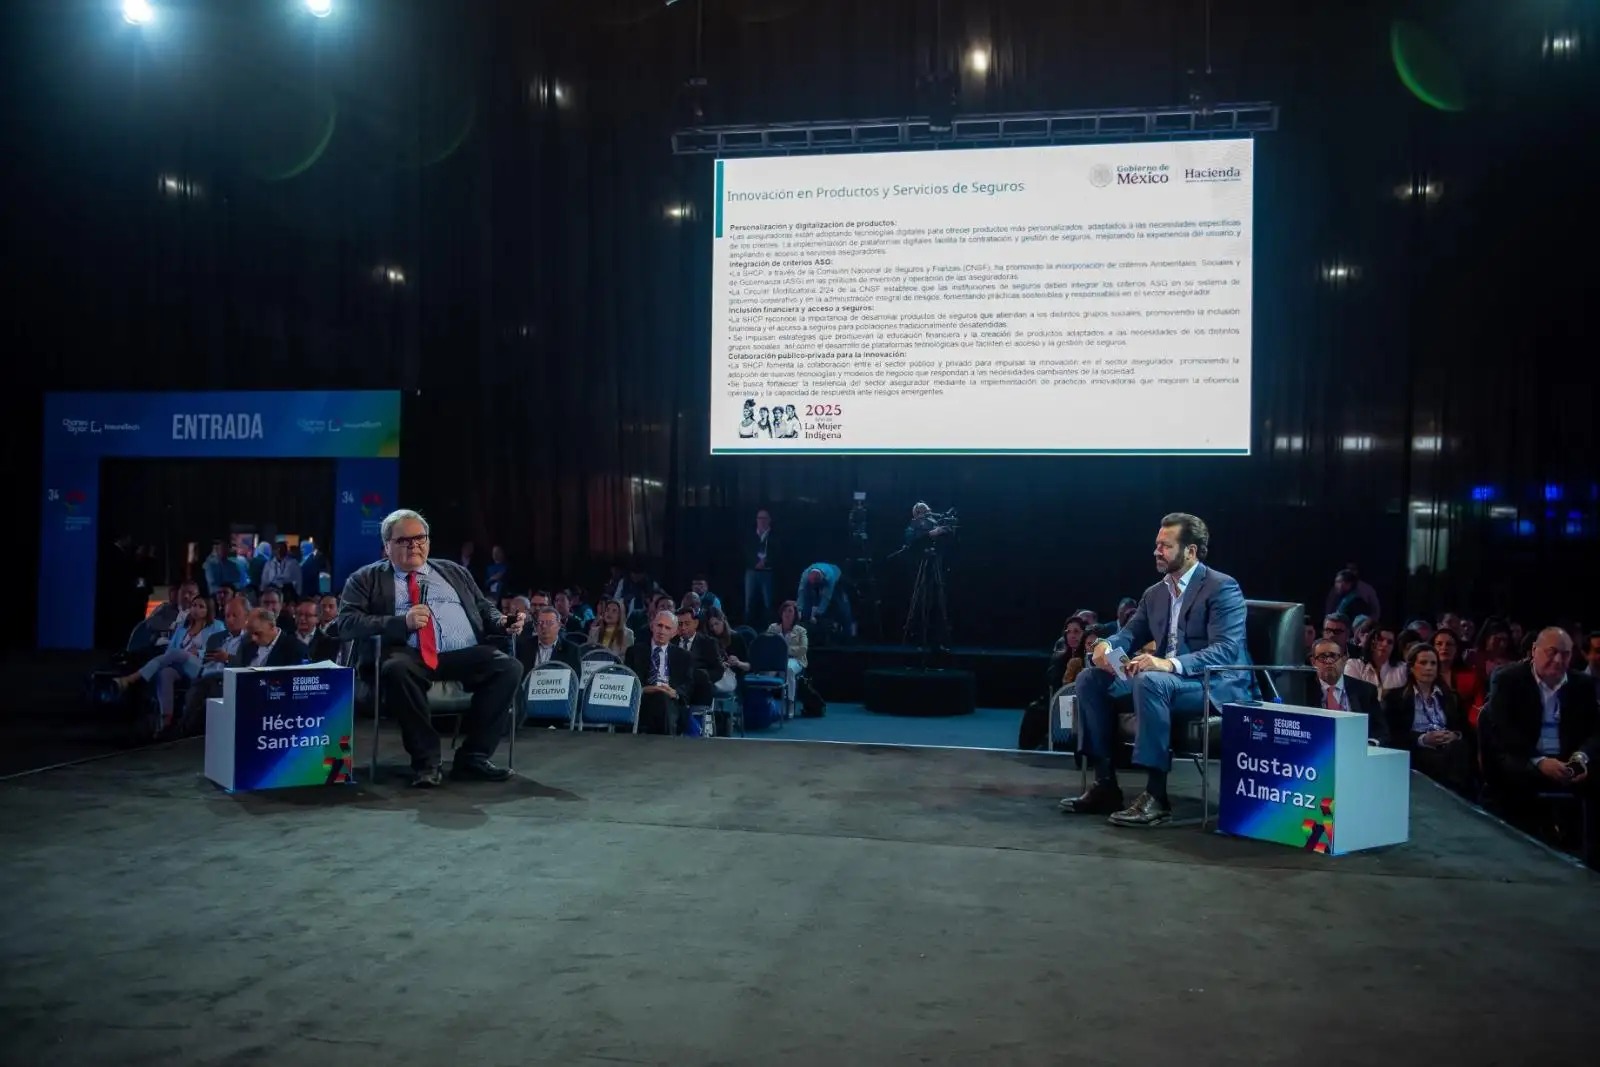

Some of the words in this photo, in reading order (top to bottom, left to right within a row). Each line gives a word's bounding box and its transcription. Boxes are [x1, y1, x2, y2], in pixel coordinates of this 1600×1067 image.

[1116, 164, 1157, 173] Gobierno
[1184, 166, 1240, 178] Hacienda
[1116, 171, 1168, 185] México
[727, 188, 793, 201] Innovación
[797, 190, 812, 199] en
[816, 184, 879, 198] Productos
[882, 187, 889, 199] y
[892, 182, 948, 196] Servicios
[952, 181, 967, 194] de
[971, 179, 1024, 196] Seguros
[805, 404, 842, 416] 2025
[172, 413, 263, 440] ENTRADA
[817, 422, 842, 432] Mujer
[804, 430, 841, 441] Indígena
[293, 676, 320, 685] SEGUROS
[593, 692, 628, 701] EJECUTIVO
[262, 714, 325, 731] Héctor
[1274, 718, 1300, 730] SEGUROS
[257, 734, 330, 750] Santana
[1236, 752, 1317, 781] Gustavo
[1236, 778, 1316, 809] Almaraz
